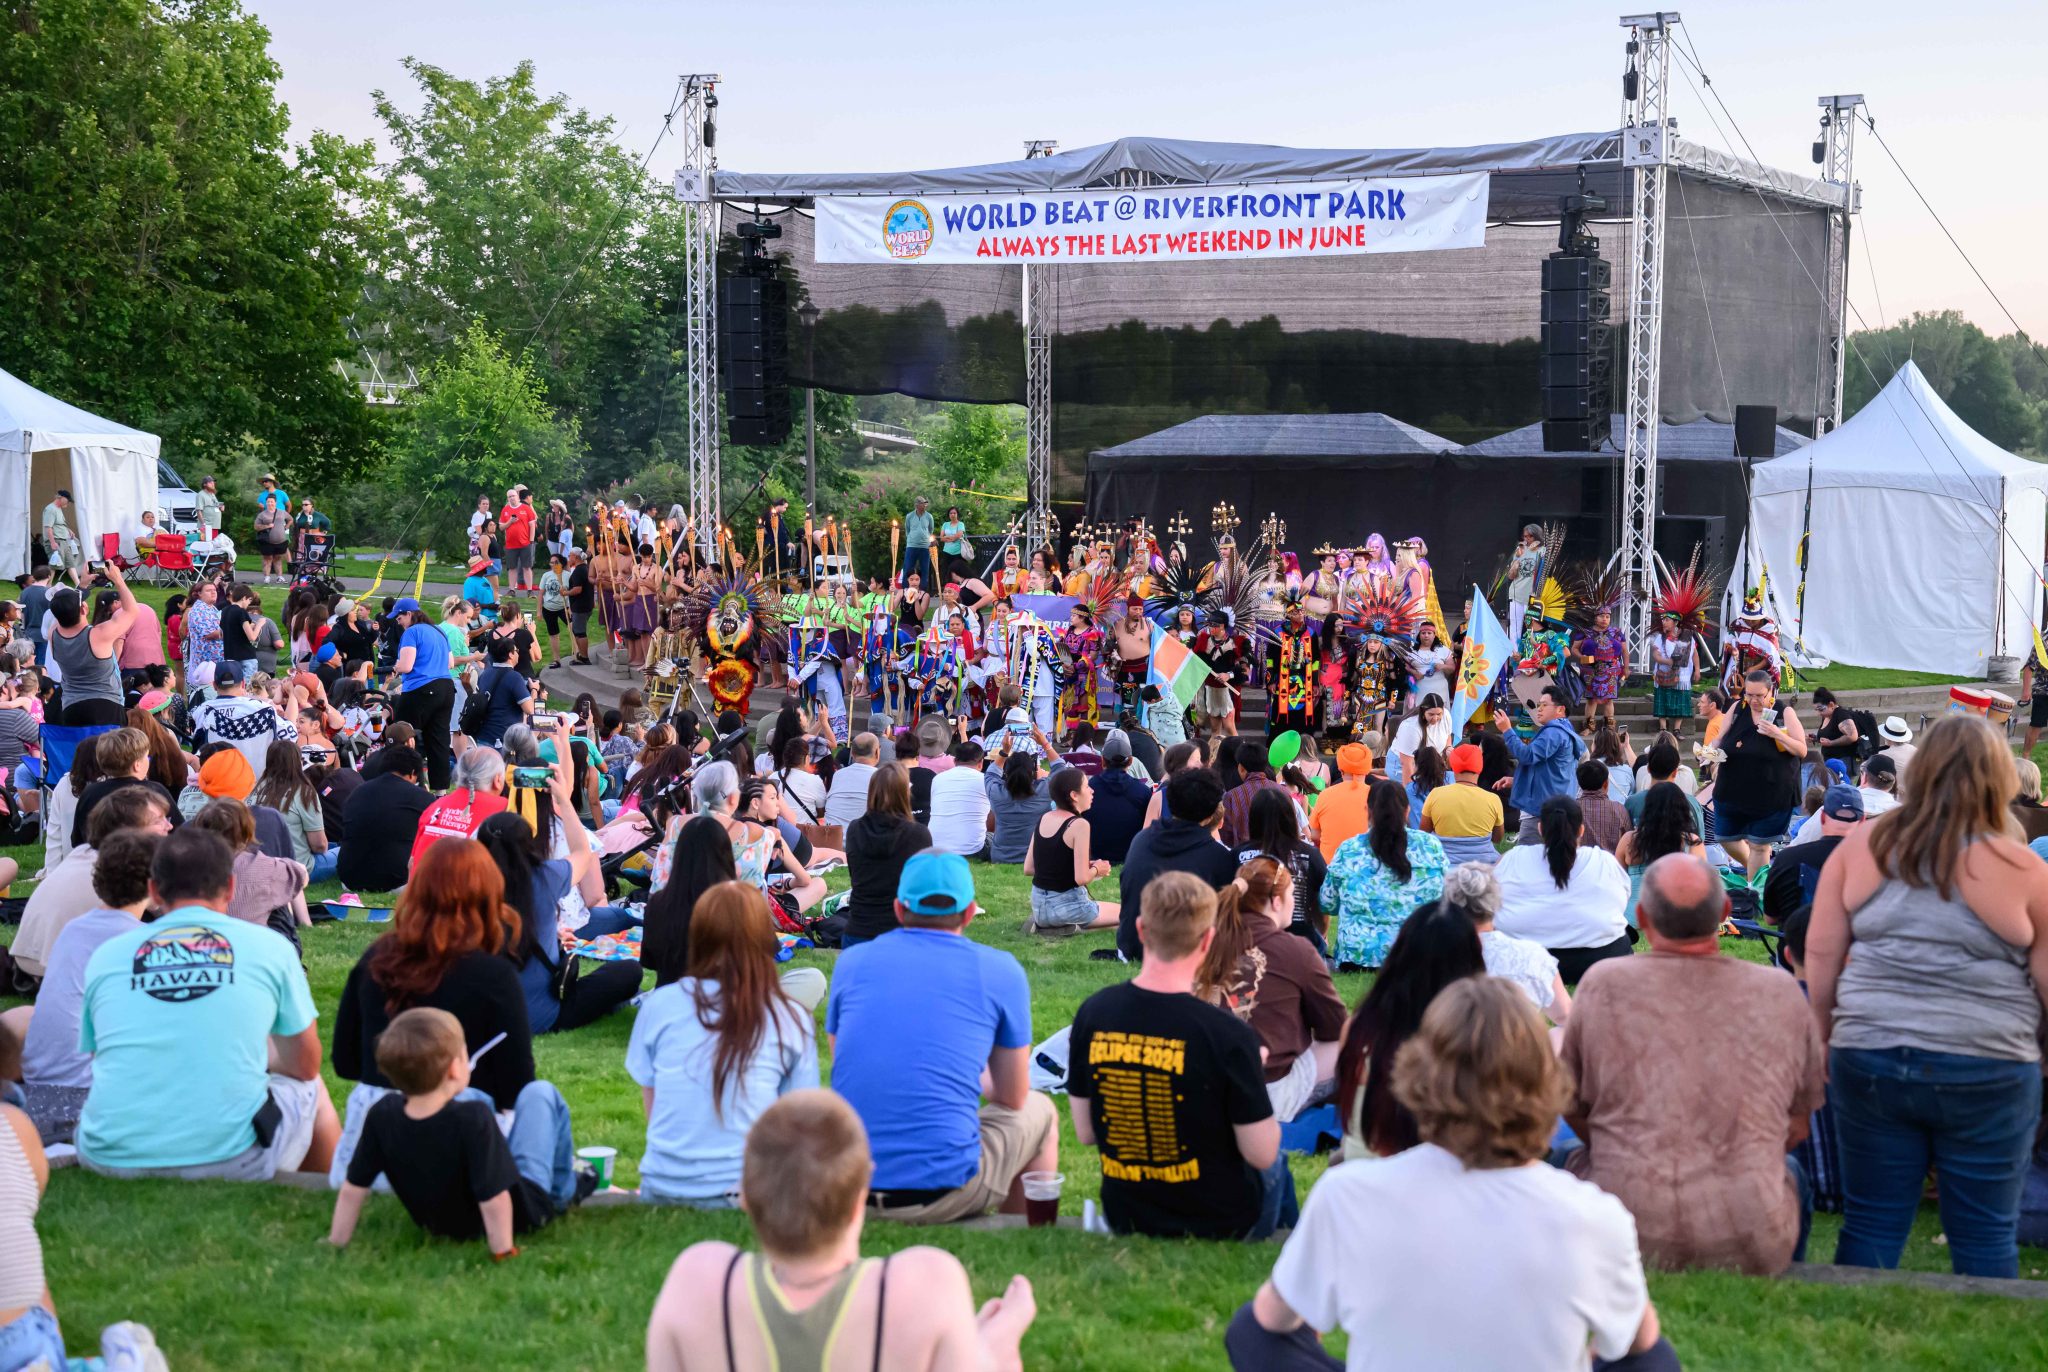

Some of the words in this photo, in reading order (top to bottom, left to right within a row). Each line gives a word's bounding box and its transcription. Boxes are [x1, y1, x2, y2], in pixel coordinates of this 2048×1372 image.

[943, 203, 1037, 235] WORLD
[1045, 200, 1109, 225] BEAT
[1114, 195, 1137, 221] @
[1144, 193, 1321, 220] RIVERFRONT
[1328, 188, 1407, 221] PARK
[885, 230, 932, 245] WORLD
[976, 235, 1060, 257] ALWAYS
[1064, 235, 1105, 256] THE
[1112, 234, 1161, 255] LAST
[1165, 229, 1272, 254] WEEKEND
[1278, 227, 1303, 250] IN
[1308, 224, 1366, 251] JUNE
[892, 243, 927, 257] BEAT
[439, 820, 470, 830] Therapy
[131, 970, 235, 991] HAWAII
[1089, 1040, 1142, 1065] ECLIPSE
[1142, 1046, 1185, 1075] 2024
